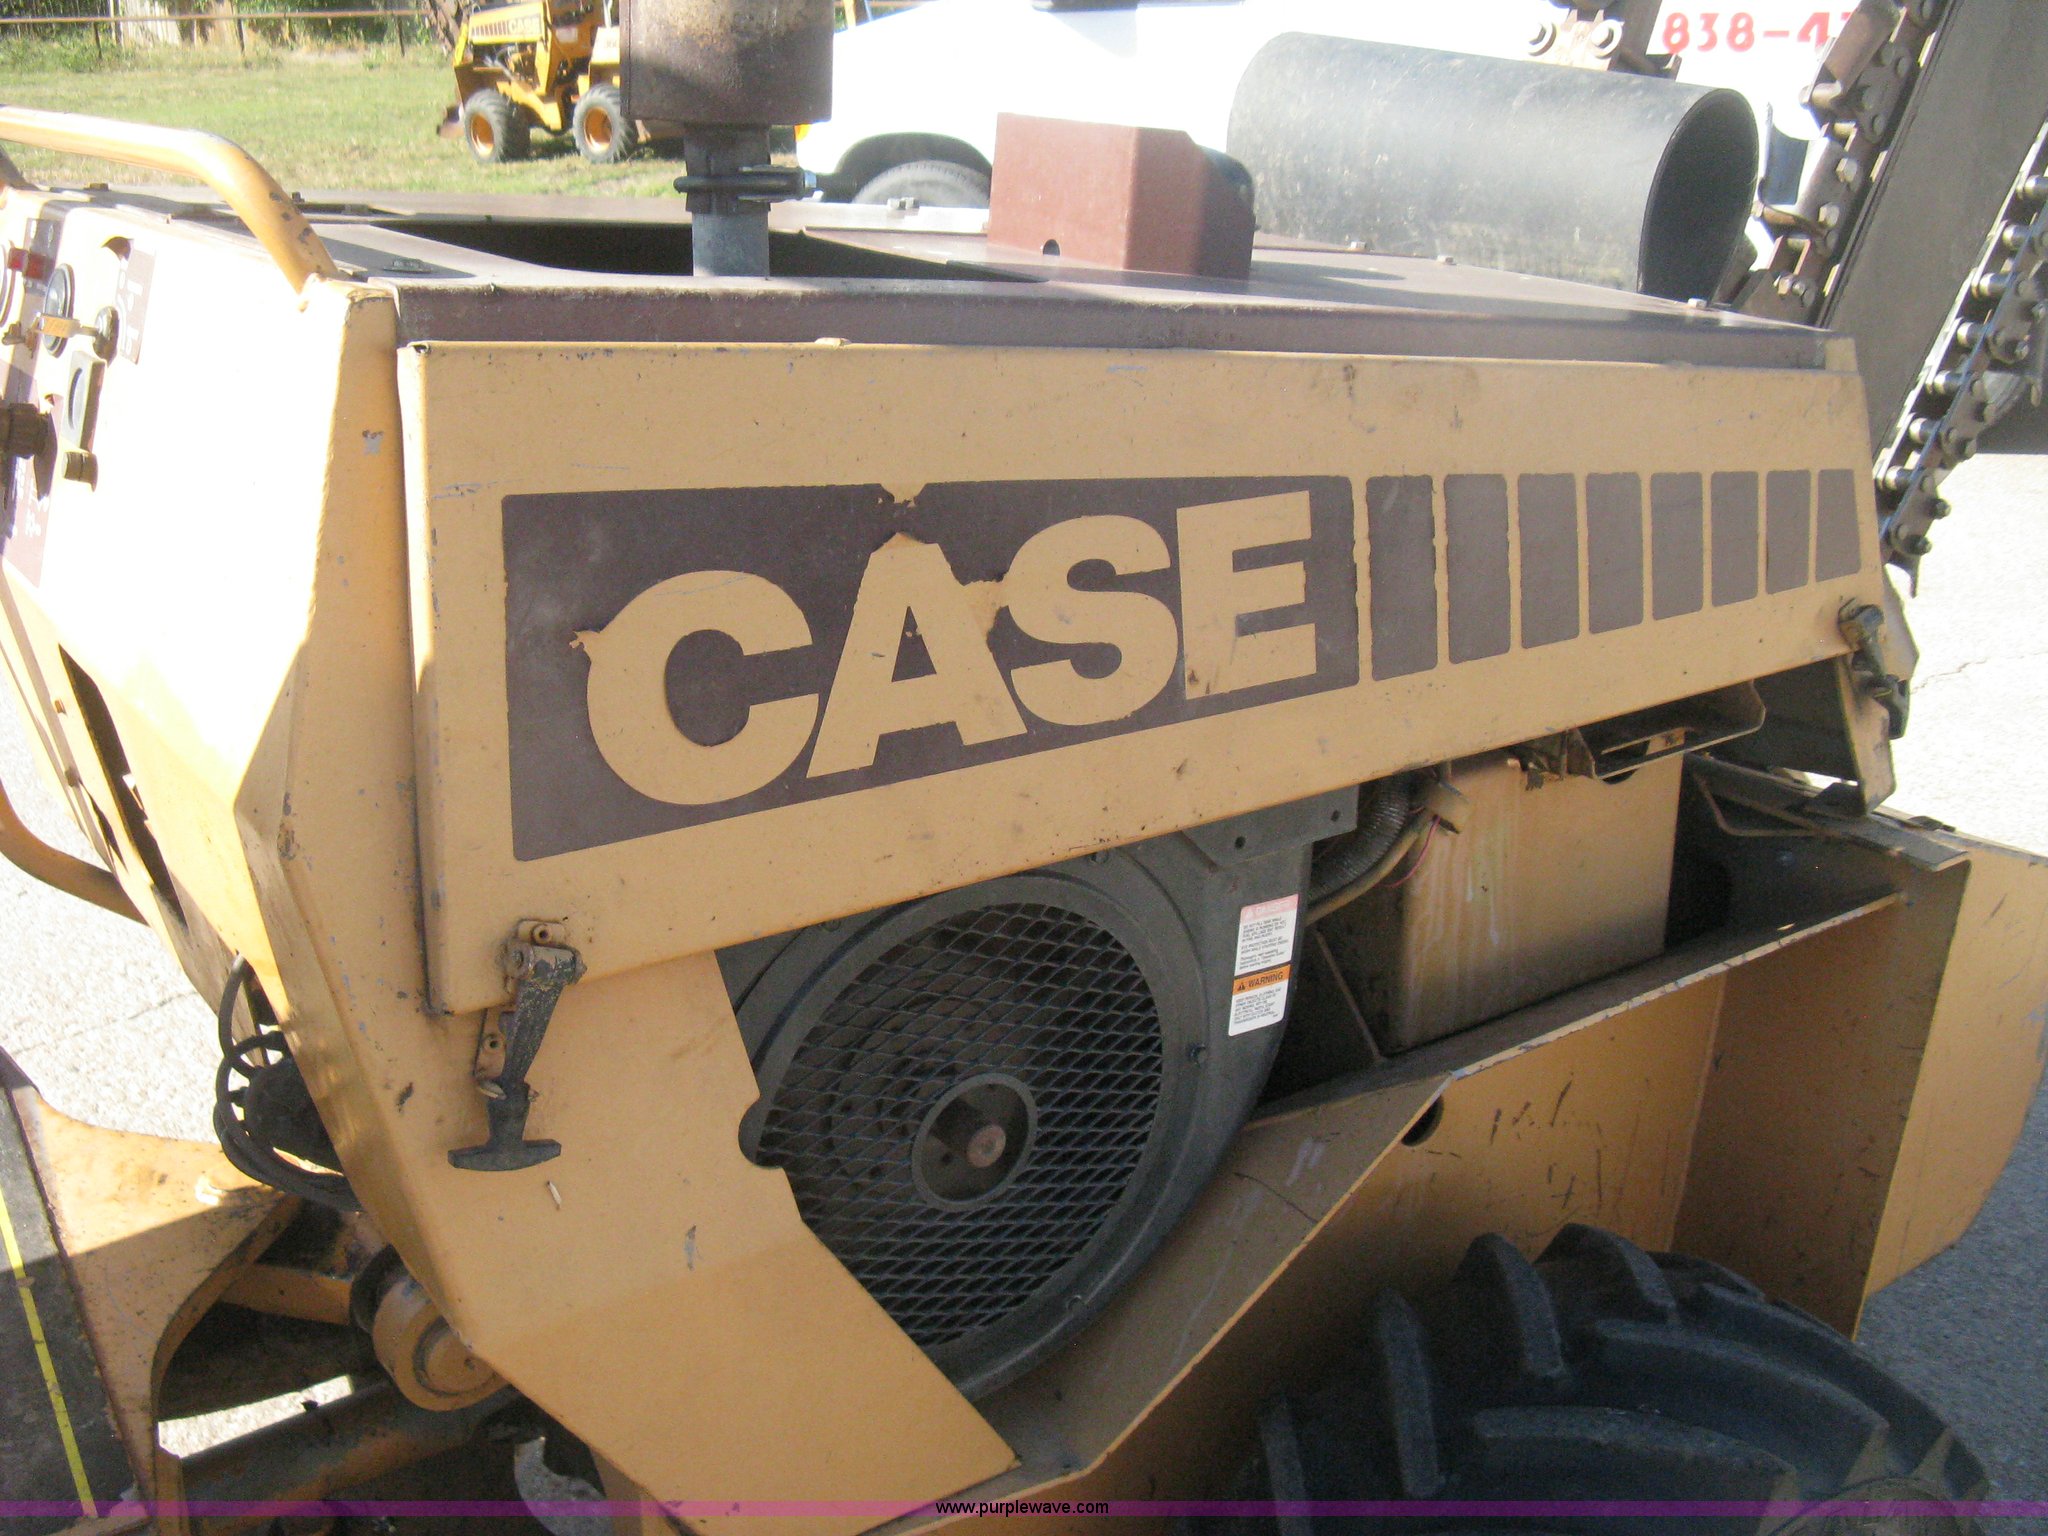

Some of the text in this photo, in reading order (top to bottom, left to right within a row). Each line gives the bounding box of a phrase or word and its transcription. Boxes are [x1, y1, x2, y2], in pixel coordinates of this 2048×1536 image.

[1662, 12, 1852, 54] 838-4
[586, 491, 1317, 806] CASE
[1248, 971, 1284, 987] WARNING
